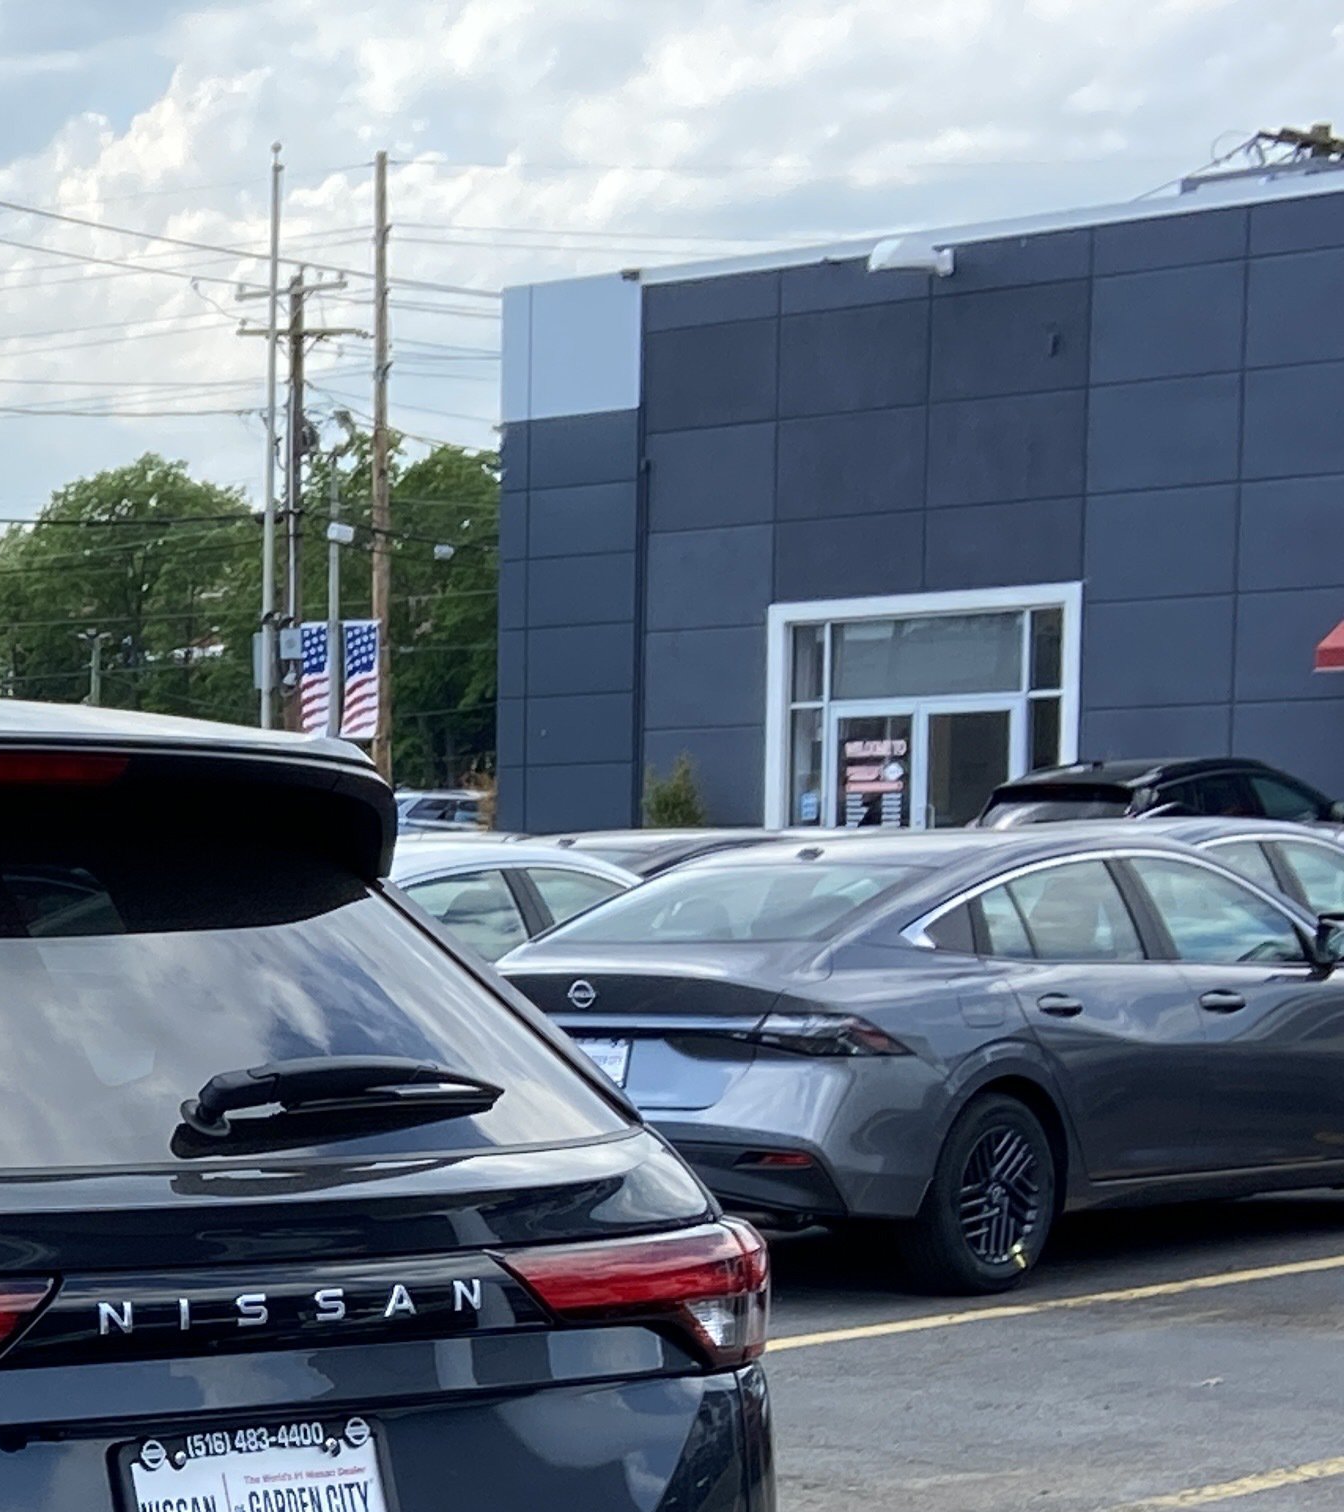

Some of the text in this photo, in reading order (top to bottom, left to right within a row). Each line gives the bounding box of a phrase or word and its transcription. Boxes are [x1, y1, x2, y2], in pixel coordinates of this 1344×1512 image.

[99, 1279, 482, 1335] NISSAN
[186, 1422, 324, 1457] (516) 483-4400
